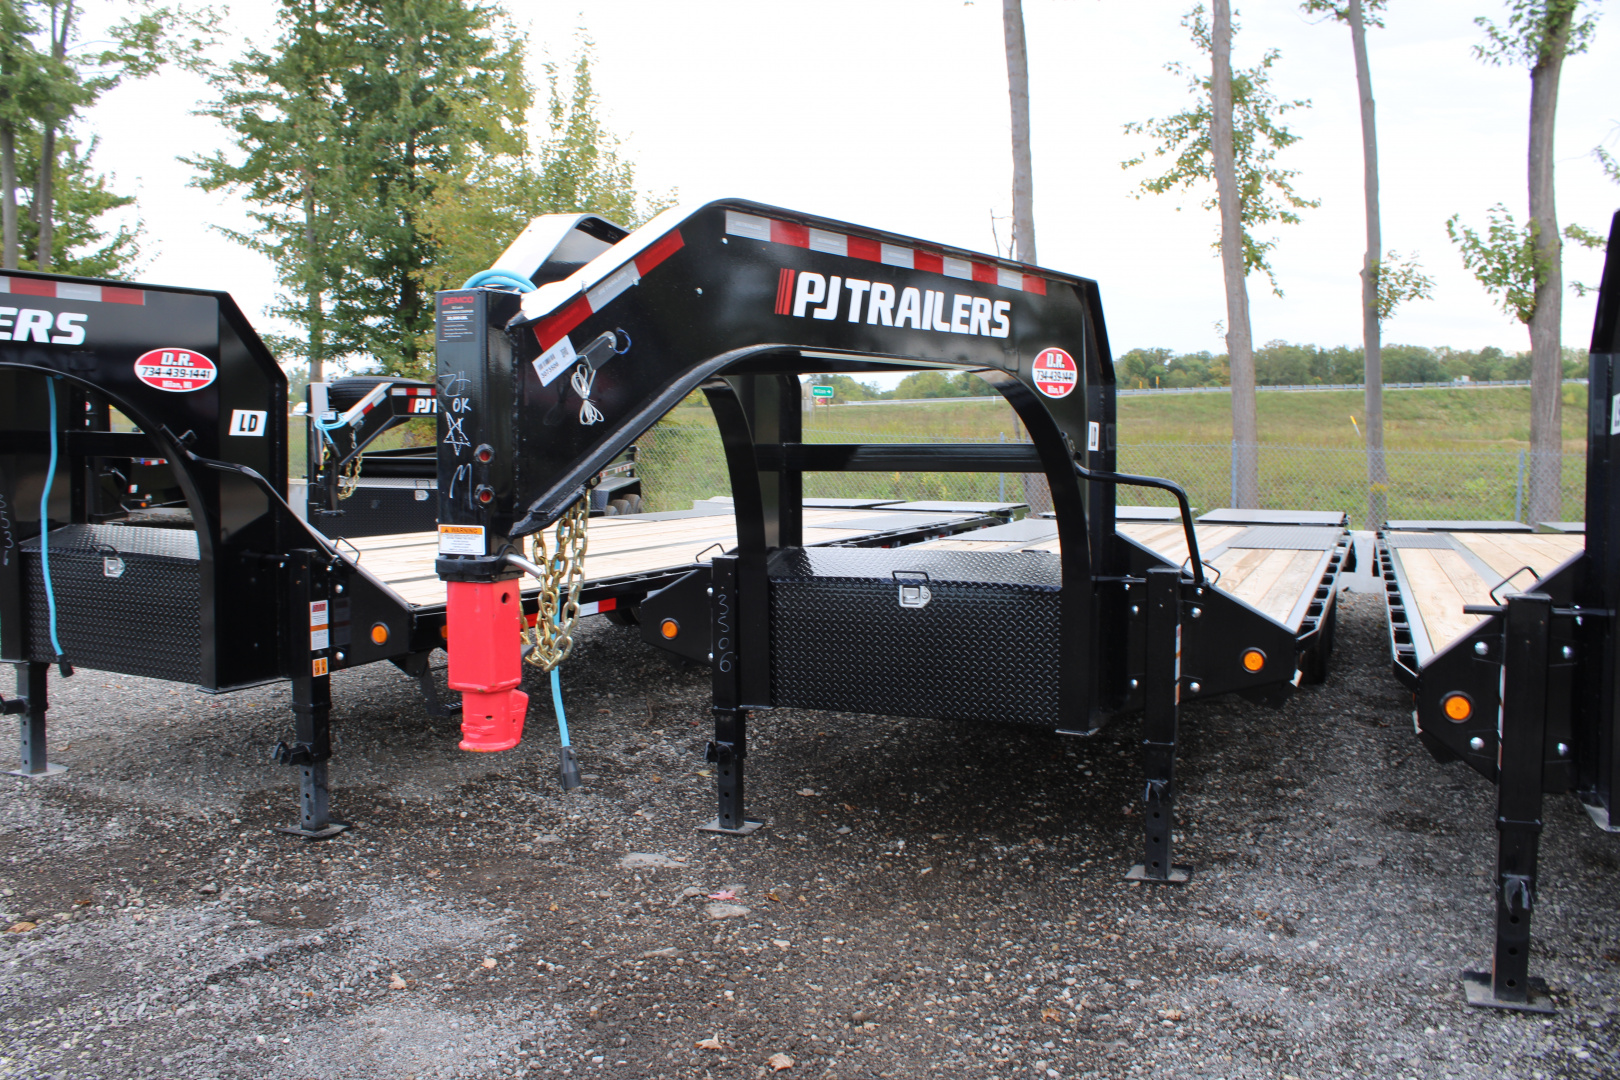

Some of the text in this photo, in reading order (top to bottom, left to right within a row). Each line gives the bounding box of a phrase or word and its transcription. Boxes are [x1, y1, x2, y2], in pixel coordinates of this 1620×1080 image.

[441, 296, 475, 306] DEMCO
[792, 271, 1011, 339] PJ TRAILERS
[160, 352, 195, 367] D.R.
[1046, 352, 1065, 368] D.R.
[142, 366, 211, 379] 734-439-1441
[452, 398, 472, 413] OK
[239, 414, 259, 432] LD
[717, 594, 734, 673] 3506
